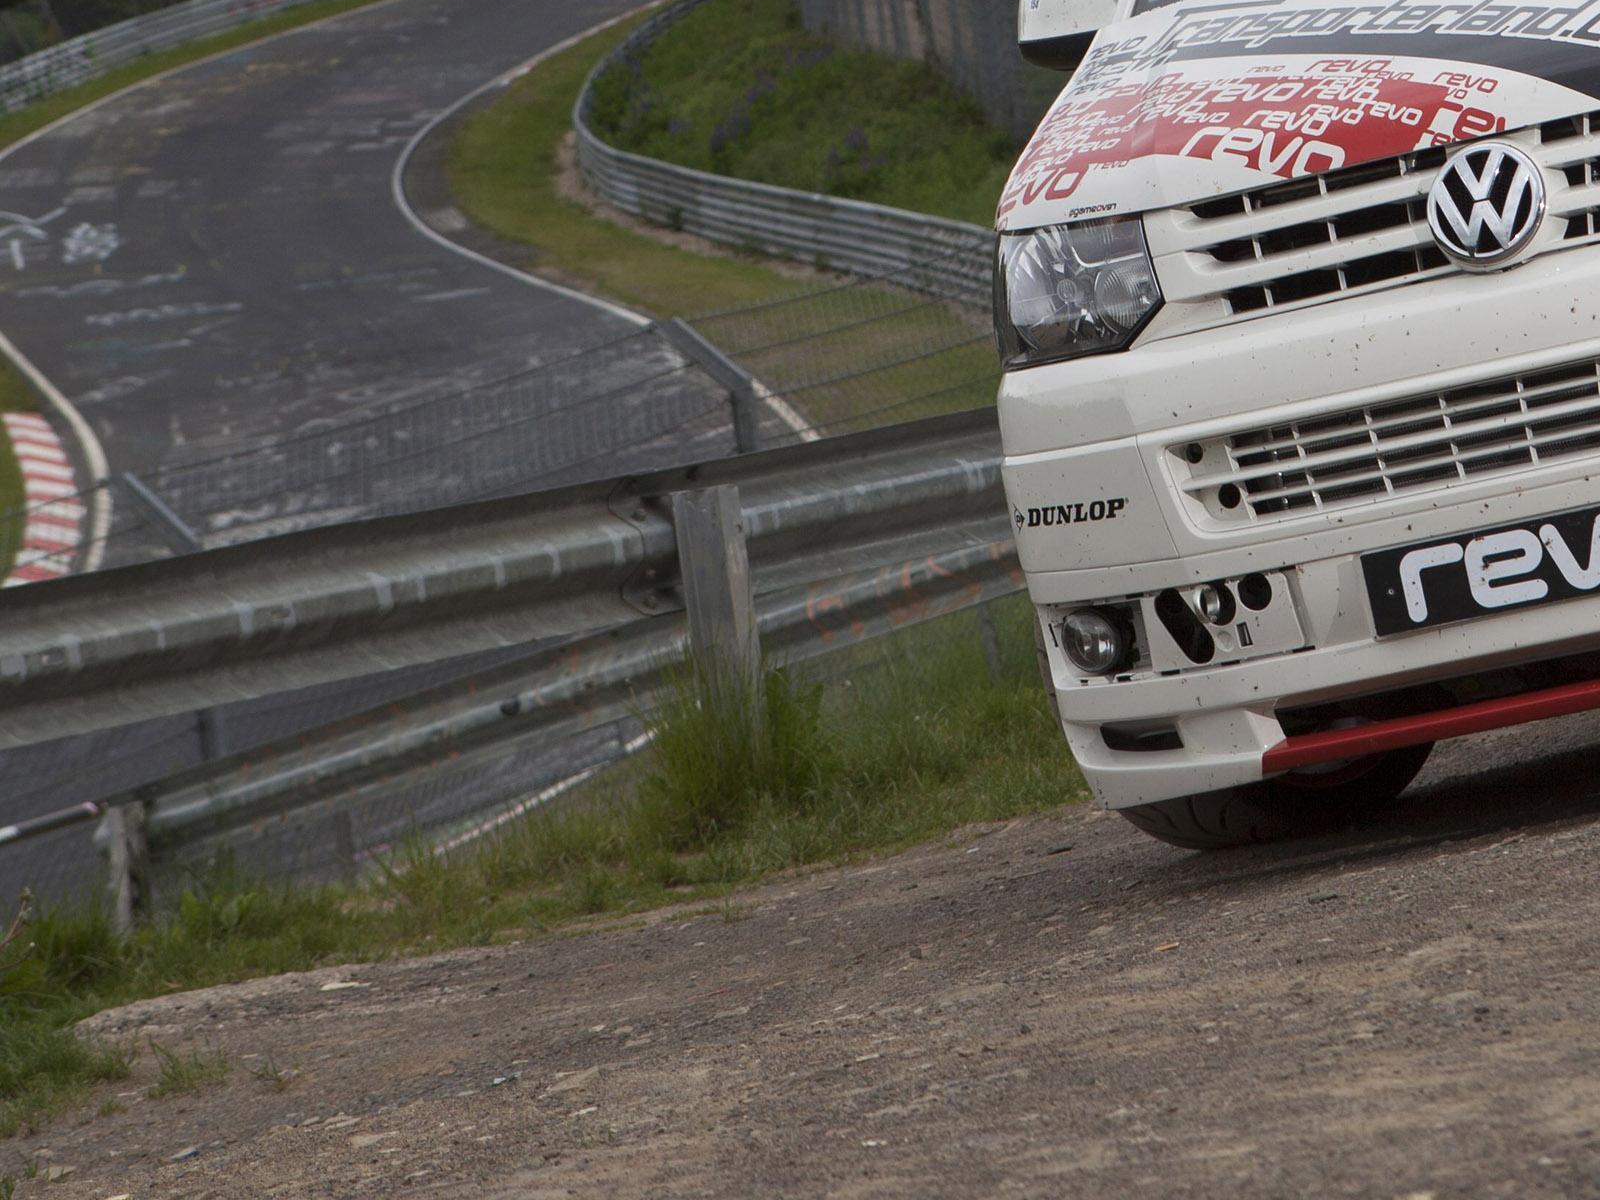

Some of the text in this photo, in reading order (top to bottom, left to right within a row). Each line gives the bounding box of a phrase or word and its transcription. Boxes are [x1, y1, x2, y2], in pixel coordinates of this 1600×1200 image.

[1247, 65, 1286, 74] revo
[1304, 60, 1392, 73] revo
[1191, 82, 1304, 104] revo
[1433, 71, 1499, 94] revo
[1301, 85, 1380, 104] revo
[1172, 112, 1231, 124] revo
[1243, 109, 1332, 137] revo
[1300, 103, 1364, 126] revo
[1357, 100, 1423, 126] revo
[1178, 126, 1346, 179] revo
[1027, 497, 1126, 527] DUNLOP
